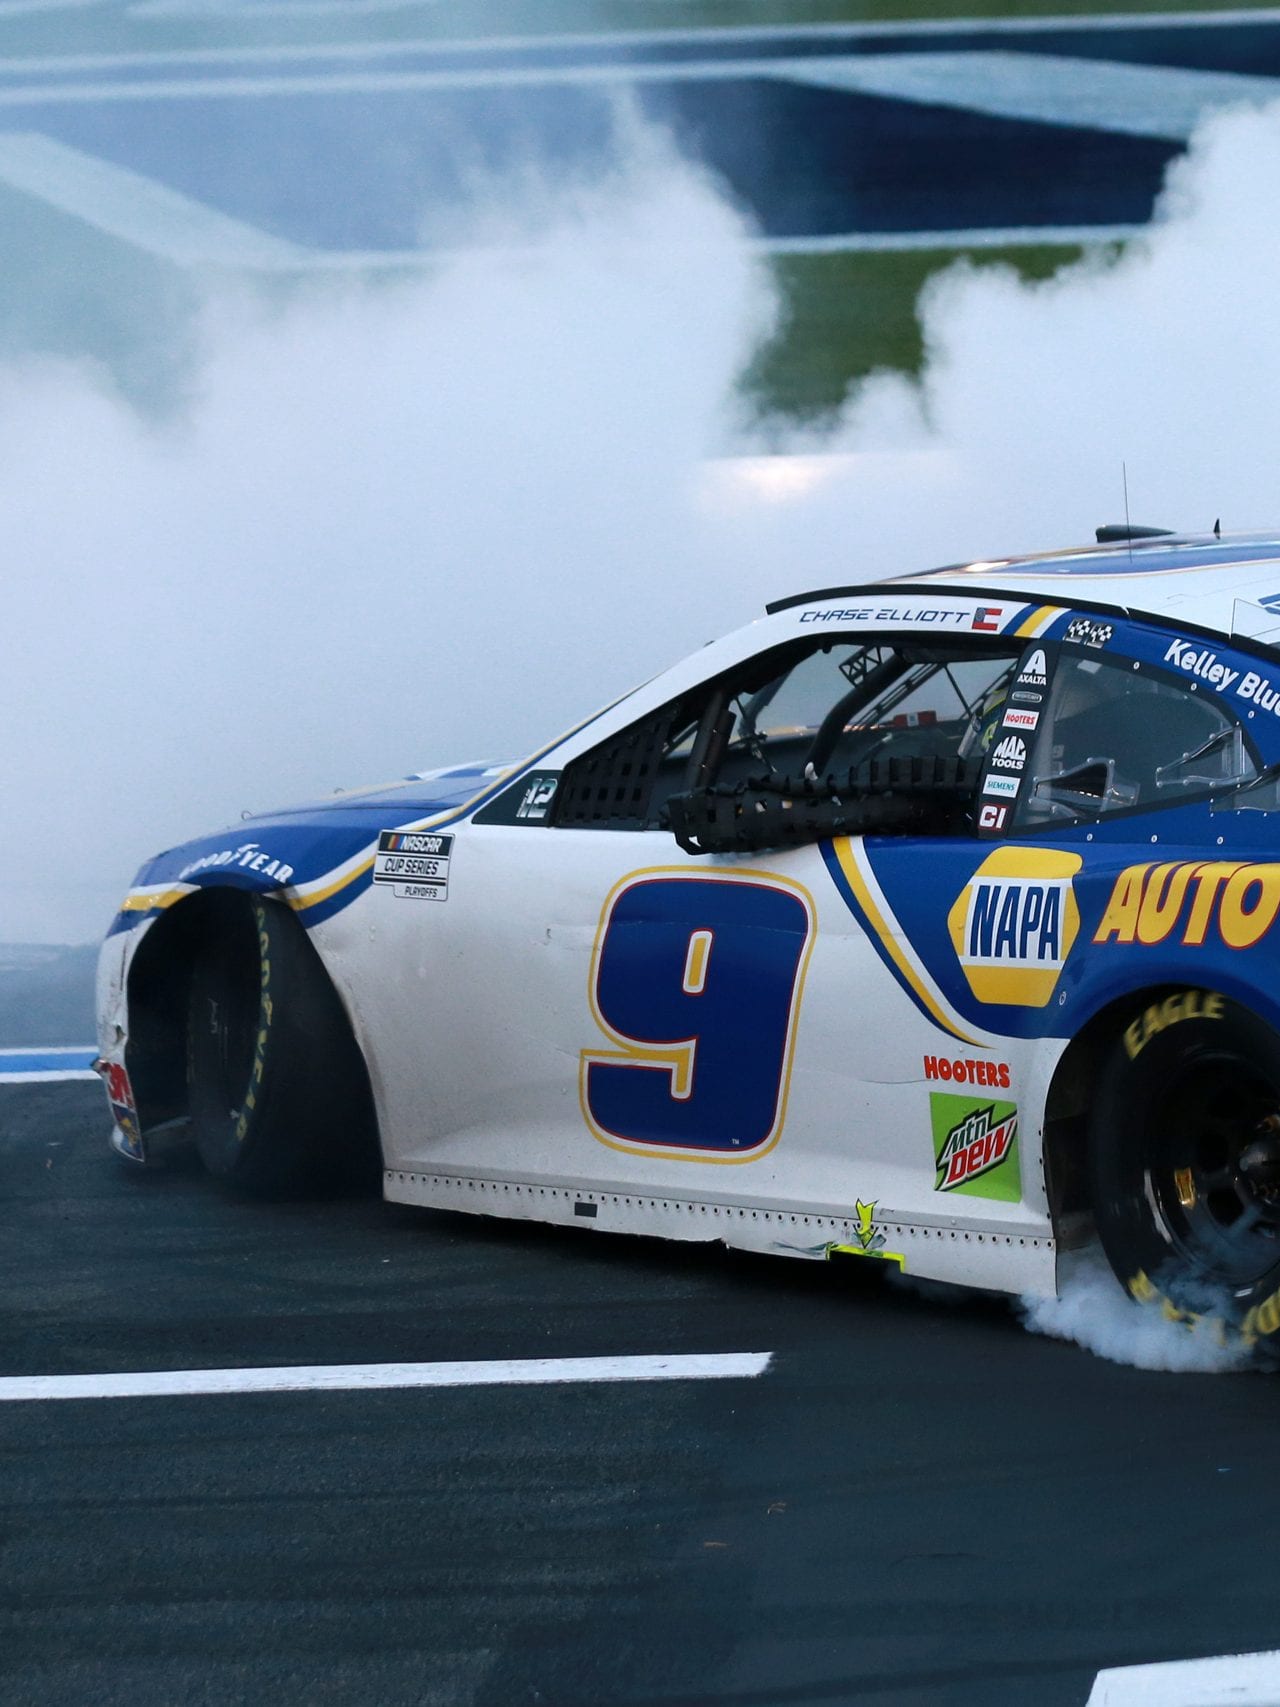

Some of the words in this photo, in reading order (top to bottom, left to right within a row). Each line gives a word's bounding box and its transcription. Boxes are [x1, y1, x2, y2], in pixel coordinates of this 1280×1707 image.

[799, 608, 875, 623] CHASE
[875, 607, 971, 624] ELLIOTT
[1163, 638, 1241, 694] Kelley
[1016, 674, 1047, 686] AXALTA
[1005, 713, 1036, 726] HOOTERS
[993, 735, 1027, 761] MAC
[991, 758, 1025, 770] TOOLS
[986, 780, 1016, 792] SIEMENS
[401, 834, 443, 853] NASCAR
[384, 858, 405, 873] CUP
[404, 860, 440, 876] SERIES
[404, 885, 439, 898] PLAYOFFS
[970, 884, 1063, 961] NAPA
[579, 865, 817, 1164] 9
[1123, 989, 1225, 1061] EAGLE
[923, 1055, 1011, 1088] HOOTERS
